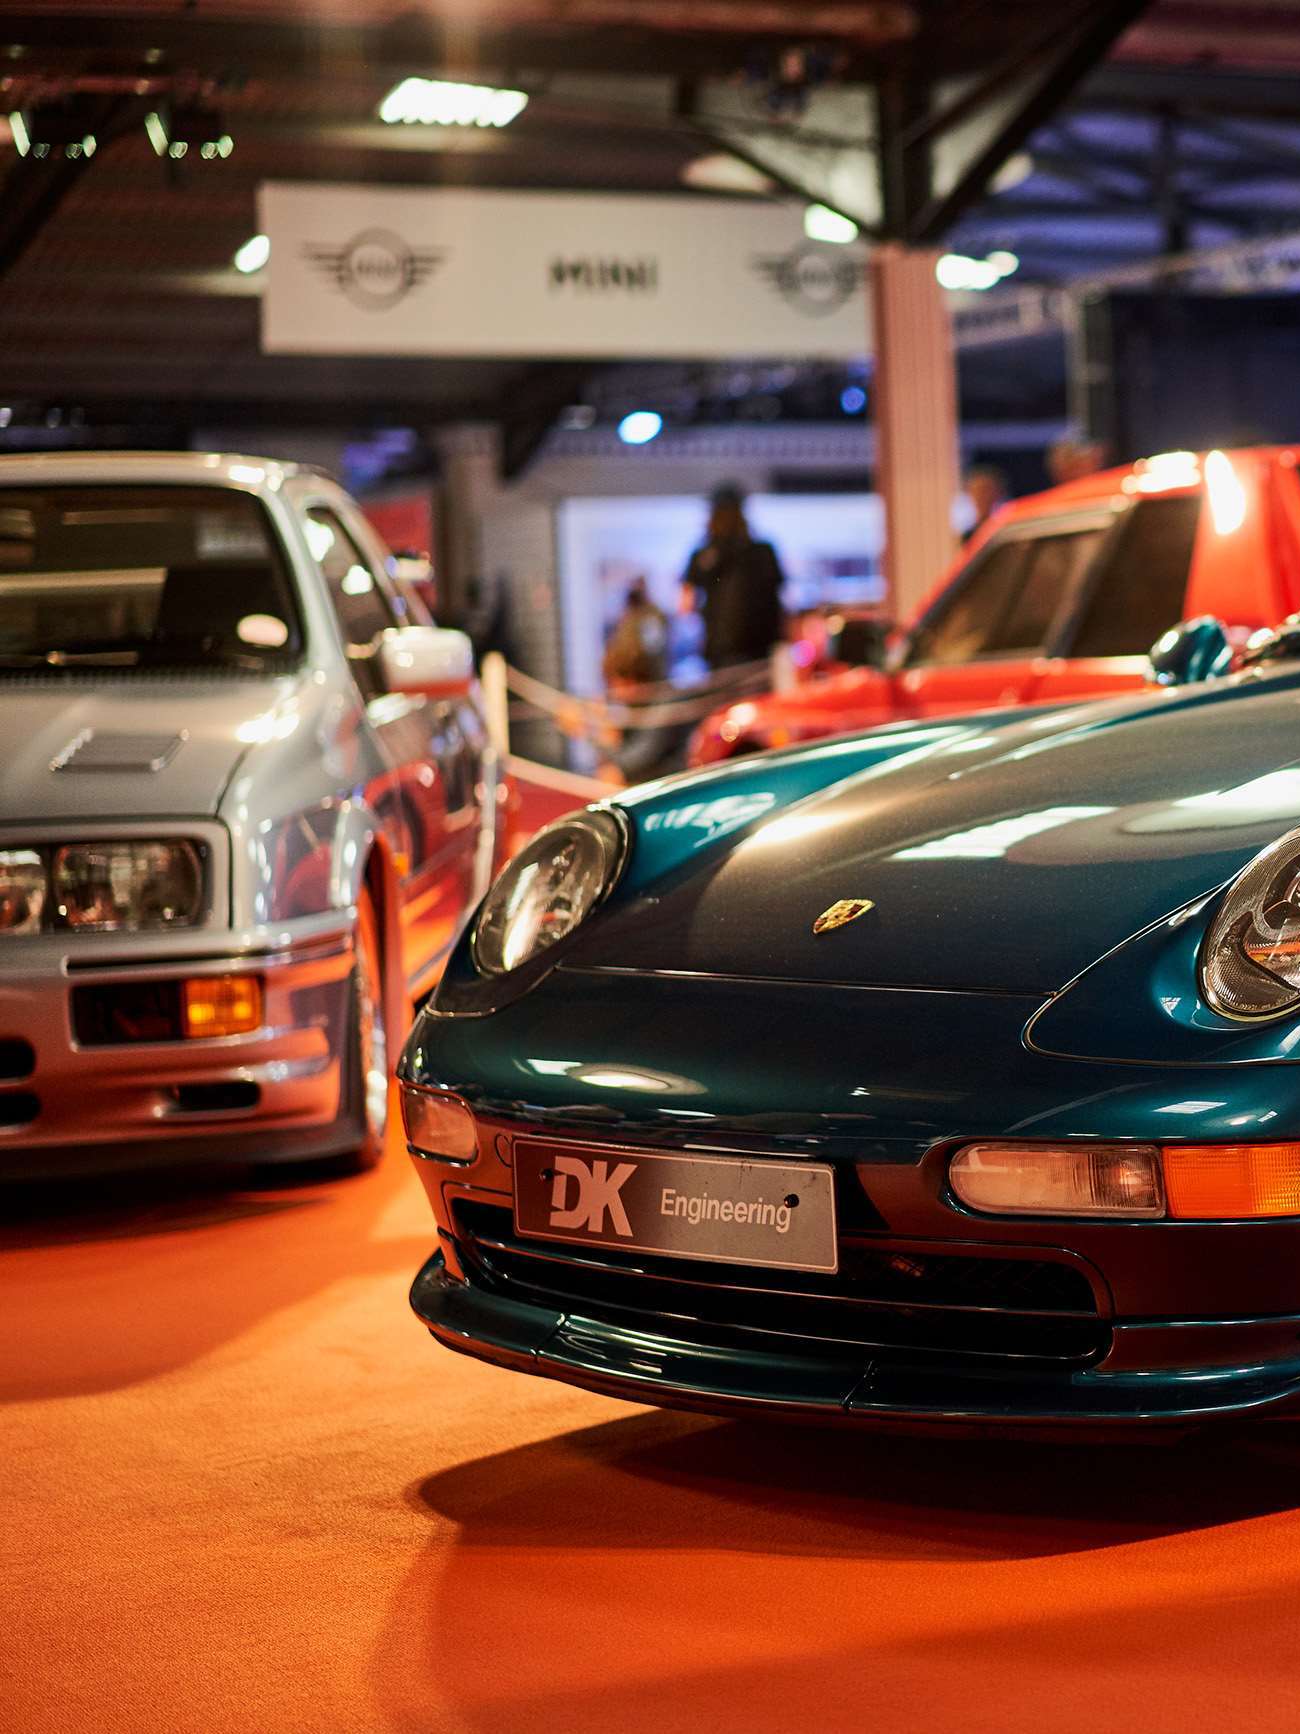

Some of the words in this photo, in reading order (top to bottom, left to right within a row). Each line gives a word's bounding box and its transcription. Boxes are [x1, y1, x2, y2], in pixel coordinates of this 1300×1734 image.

[549, 255, 657, 292] MINI
[550, 1156, 638, 1237] DK
[661, 1188, 792, 1233] Engineering
